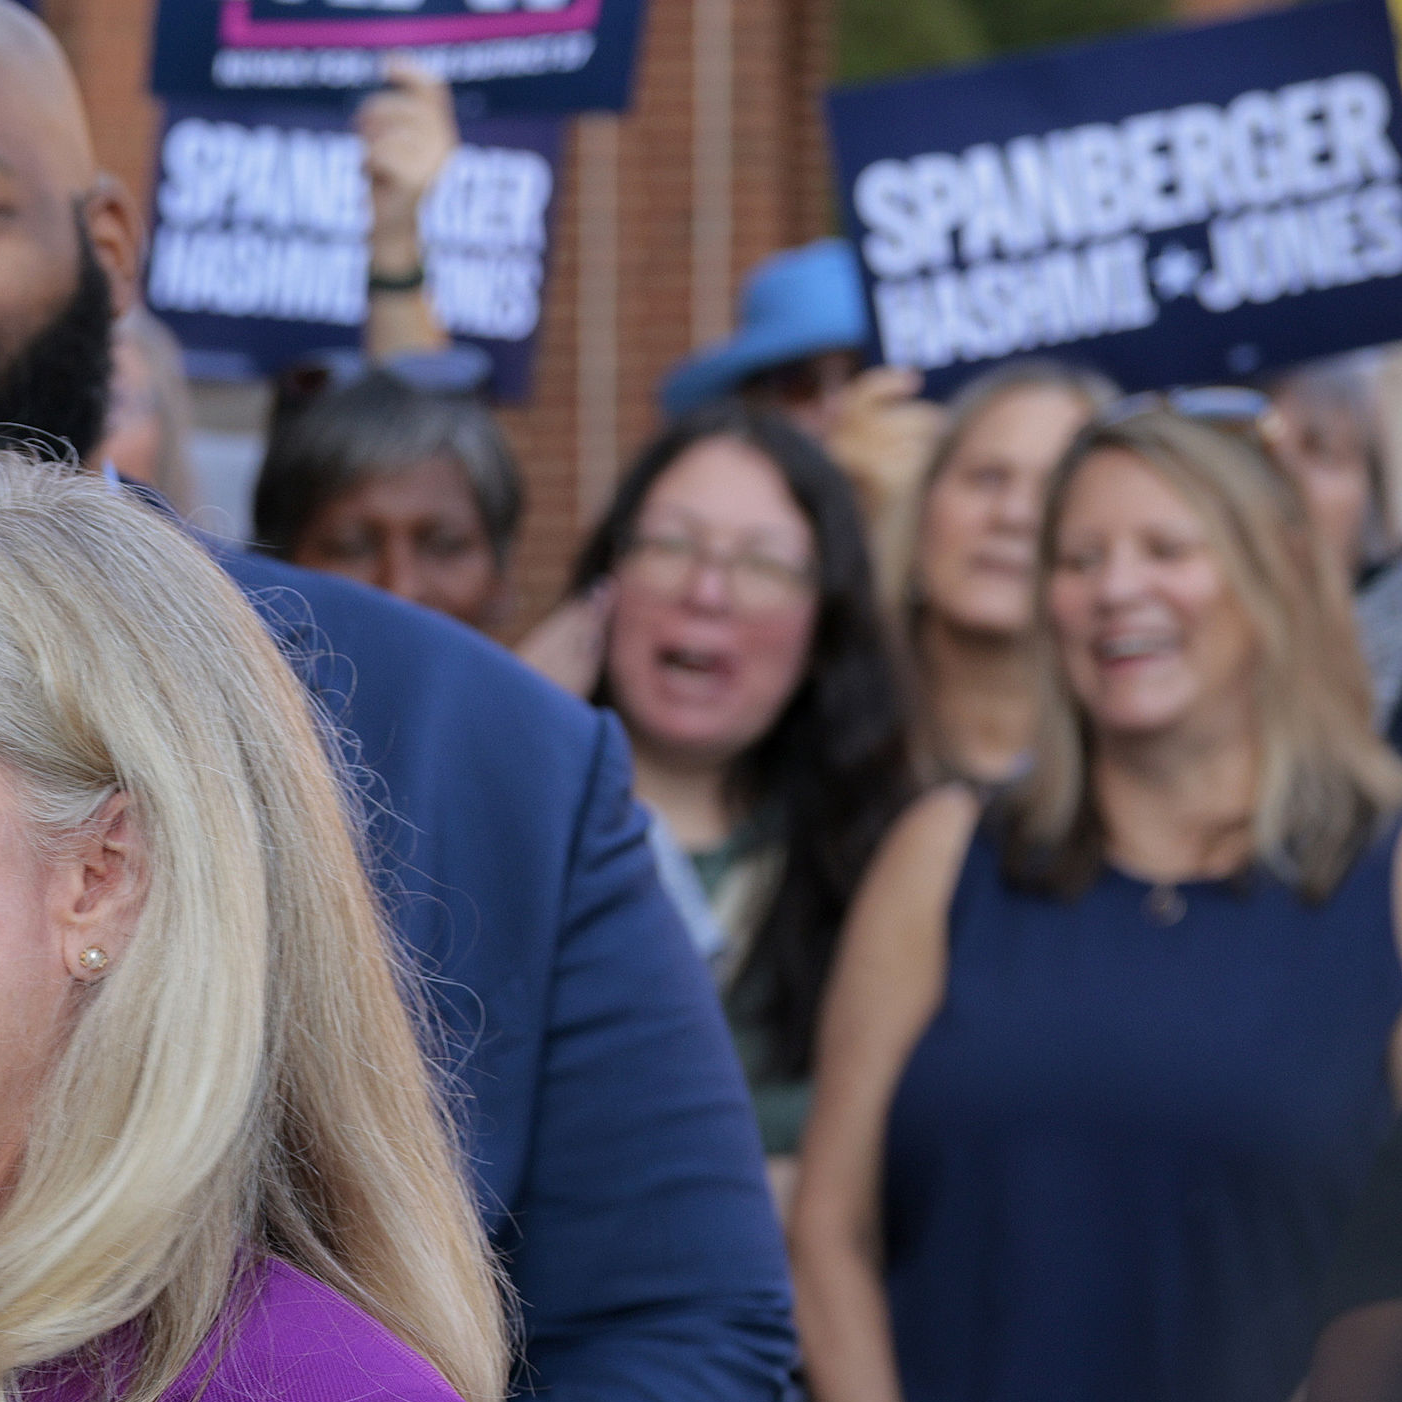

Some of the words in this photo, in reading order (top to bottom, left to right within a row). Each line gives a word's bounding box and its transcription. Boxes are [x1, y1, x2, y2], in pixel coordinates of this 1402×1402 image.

[854, 72, 1402, 280] SPANBERGER
[872, 236, 1159, 371] HASHMI
[1196, 183, 1402, 313] JONES
